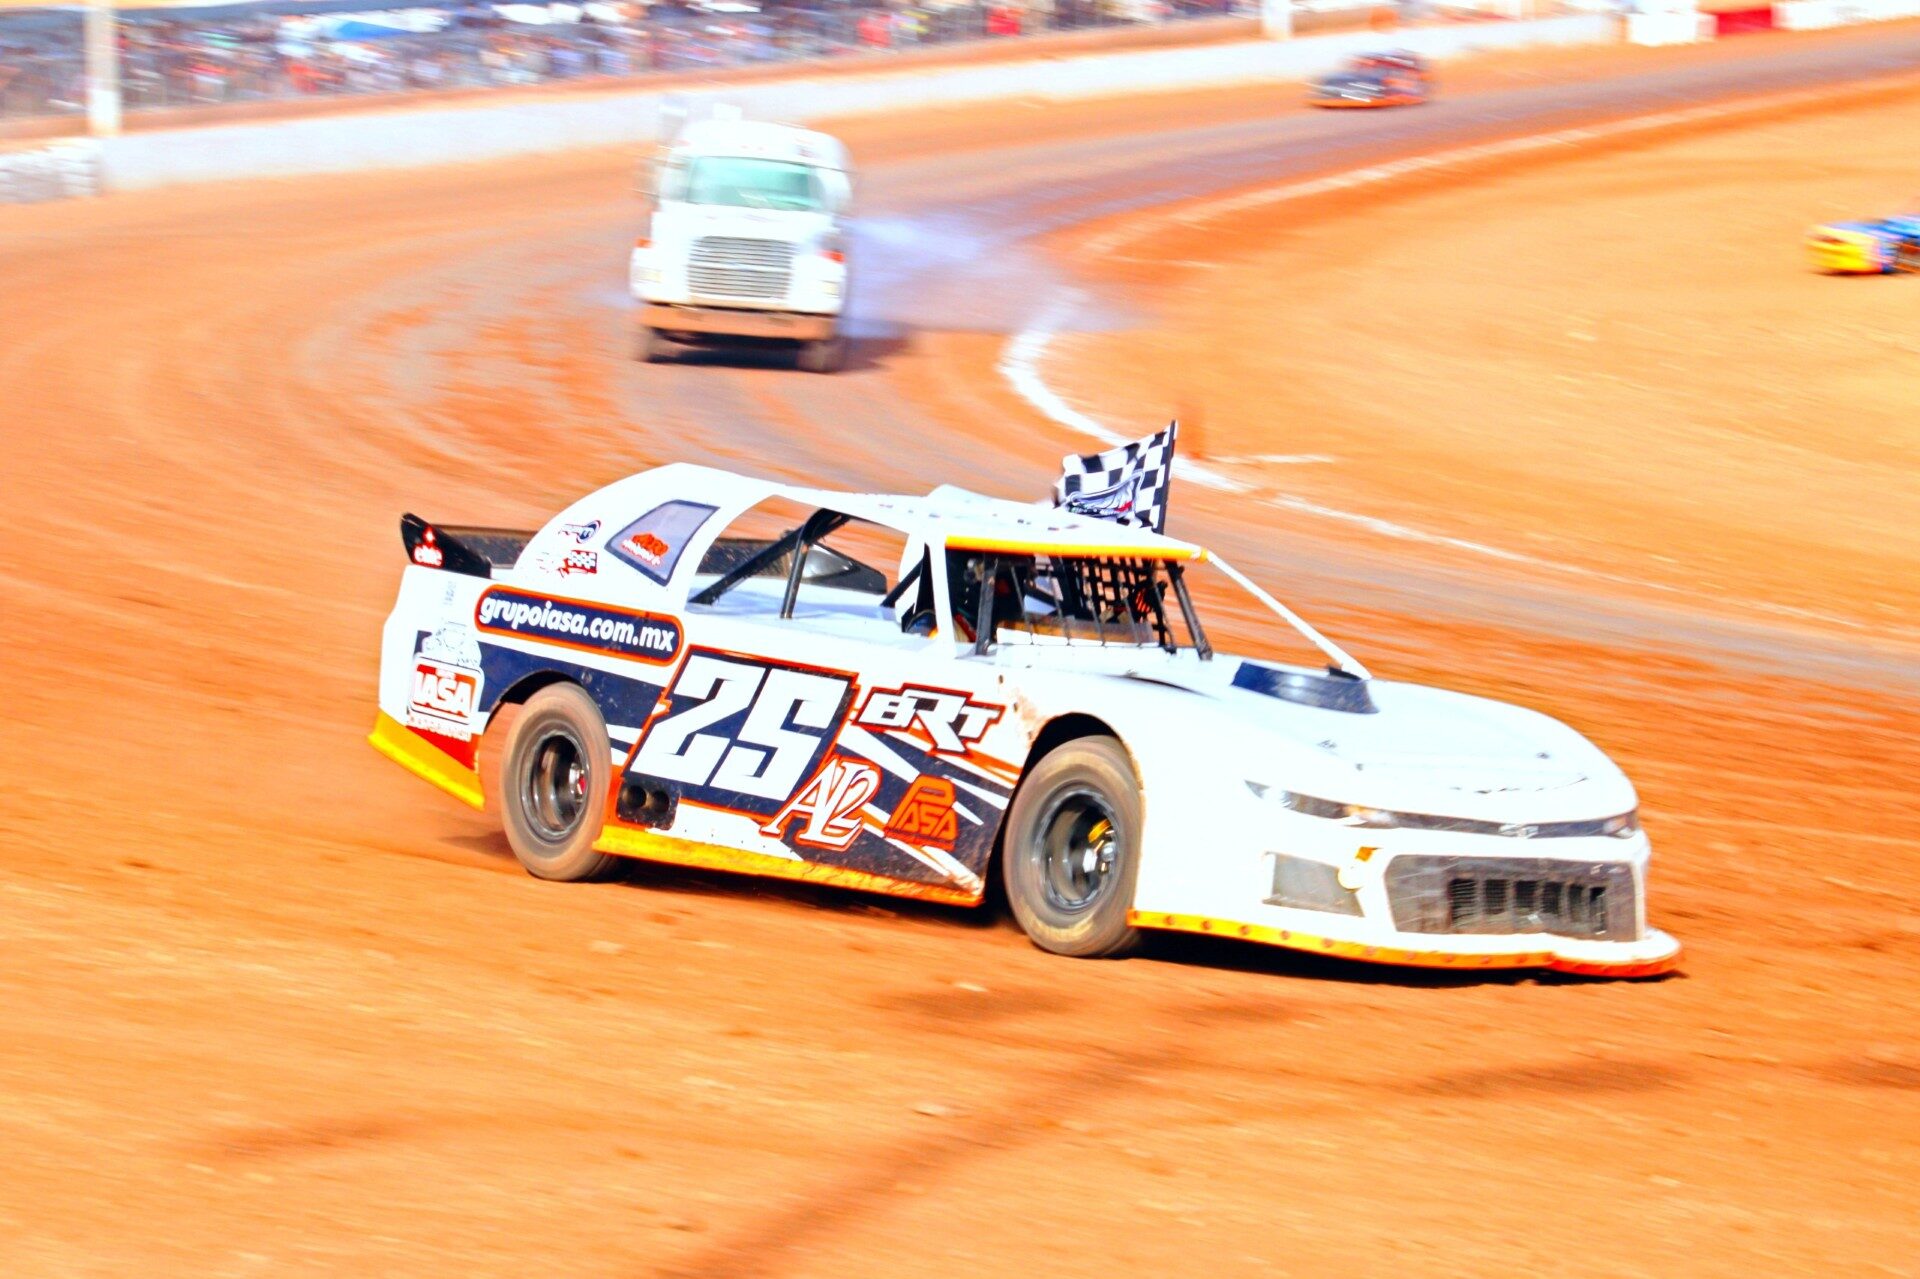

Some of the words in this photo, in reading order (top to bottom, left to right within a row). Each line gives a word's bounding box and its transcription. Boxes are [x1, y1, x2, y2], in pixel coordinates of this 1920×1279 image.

[479, 595, 676, 652] grupoiasa.com.mx
[413, 670, 471, 717] IASA
[630, 654, 850, 801] 25
